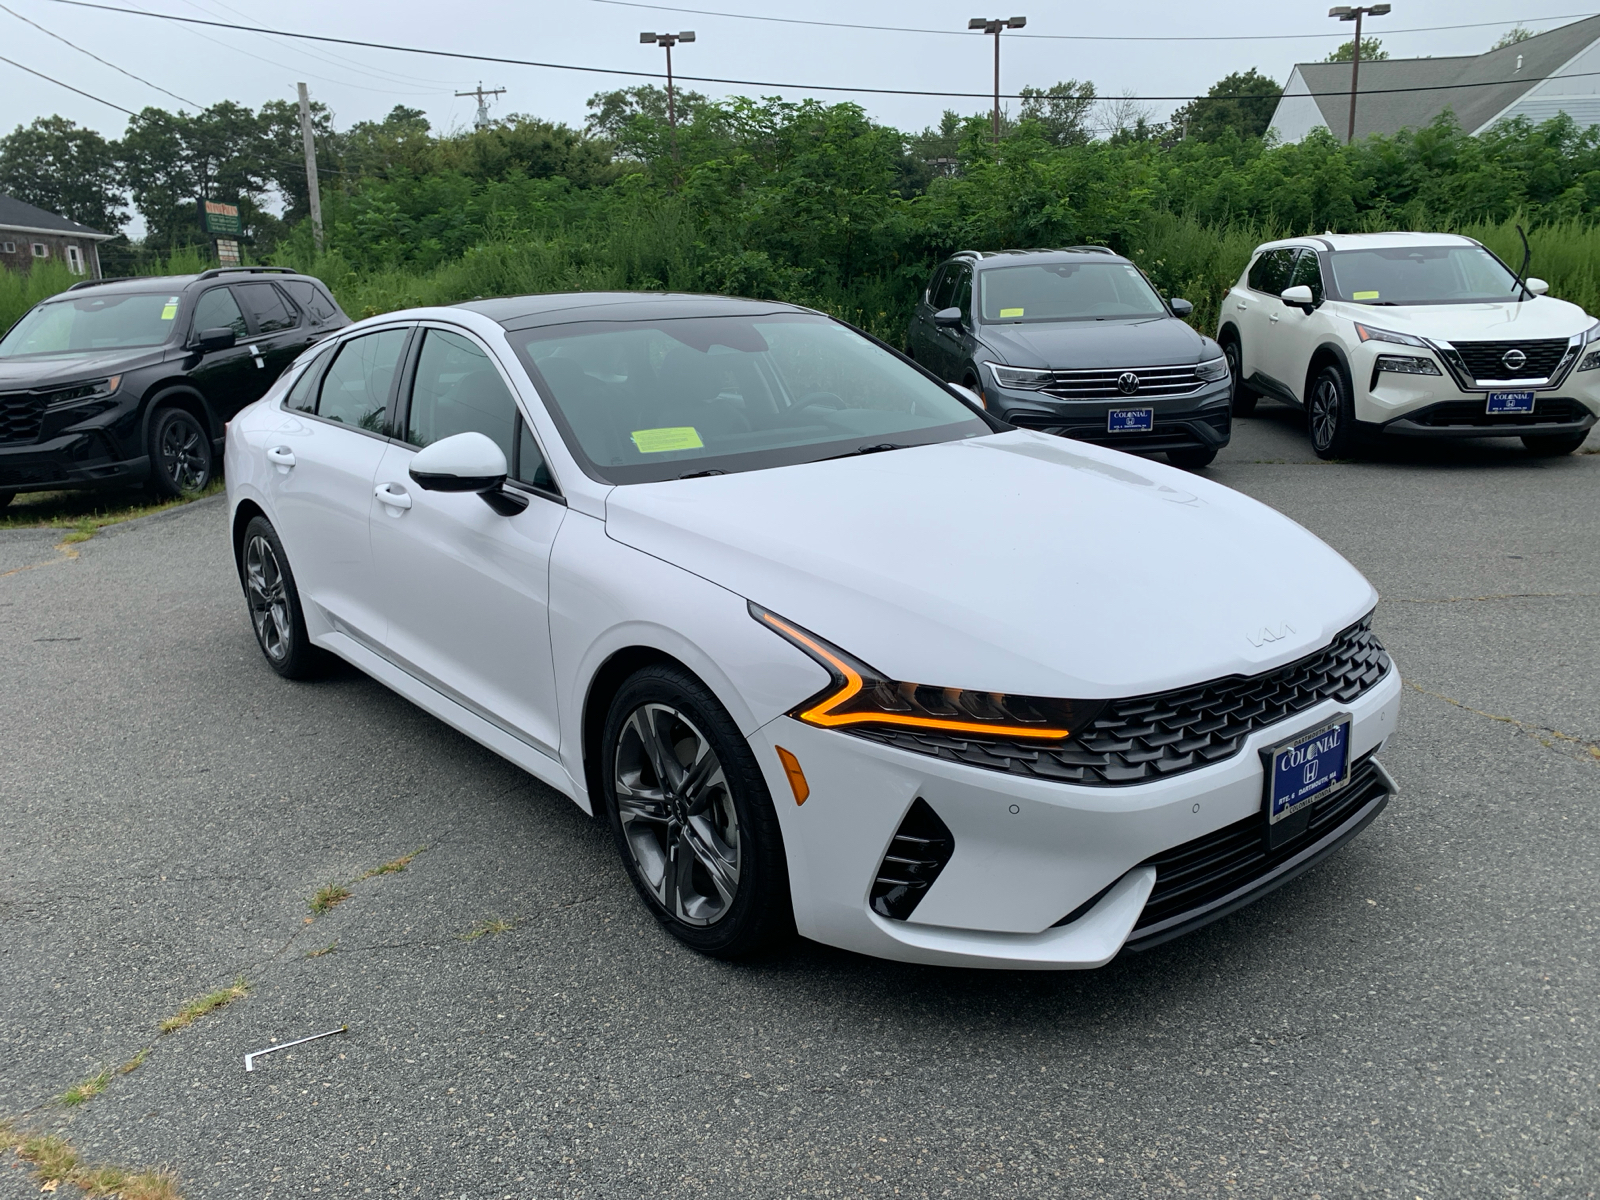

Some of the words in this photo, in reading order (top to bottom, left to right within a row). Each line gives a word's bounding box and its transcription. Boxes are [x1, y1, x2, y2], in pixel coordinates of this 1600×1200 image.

[1114, 411, 1147, 419] COLONIAL
[1281, 732, 1341, 771] COLONIAL
[1329, 771, 1337, 779] MA
[1289, 797, 1314, 813] COLONIAL
[1314, 788, 1332, 801] HONDA
